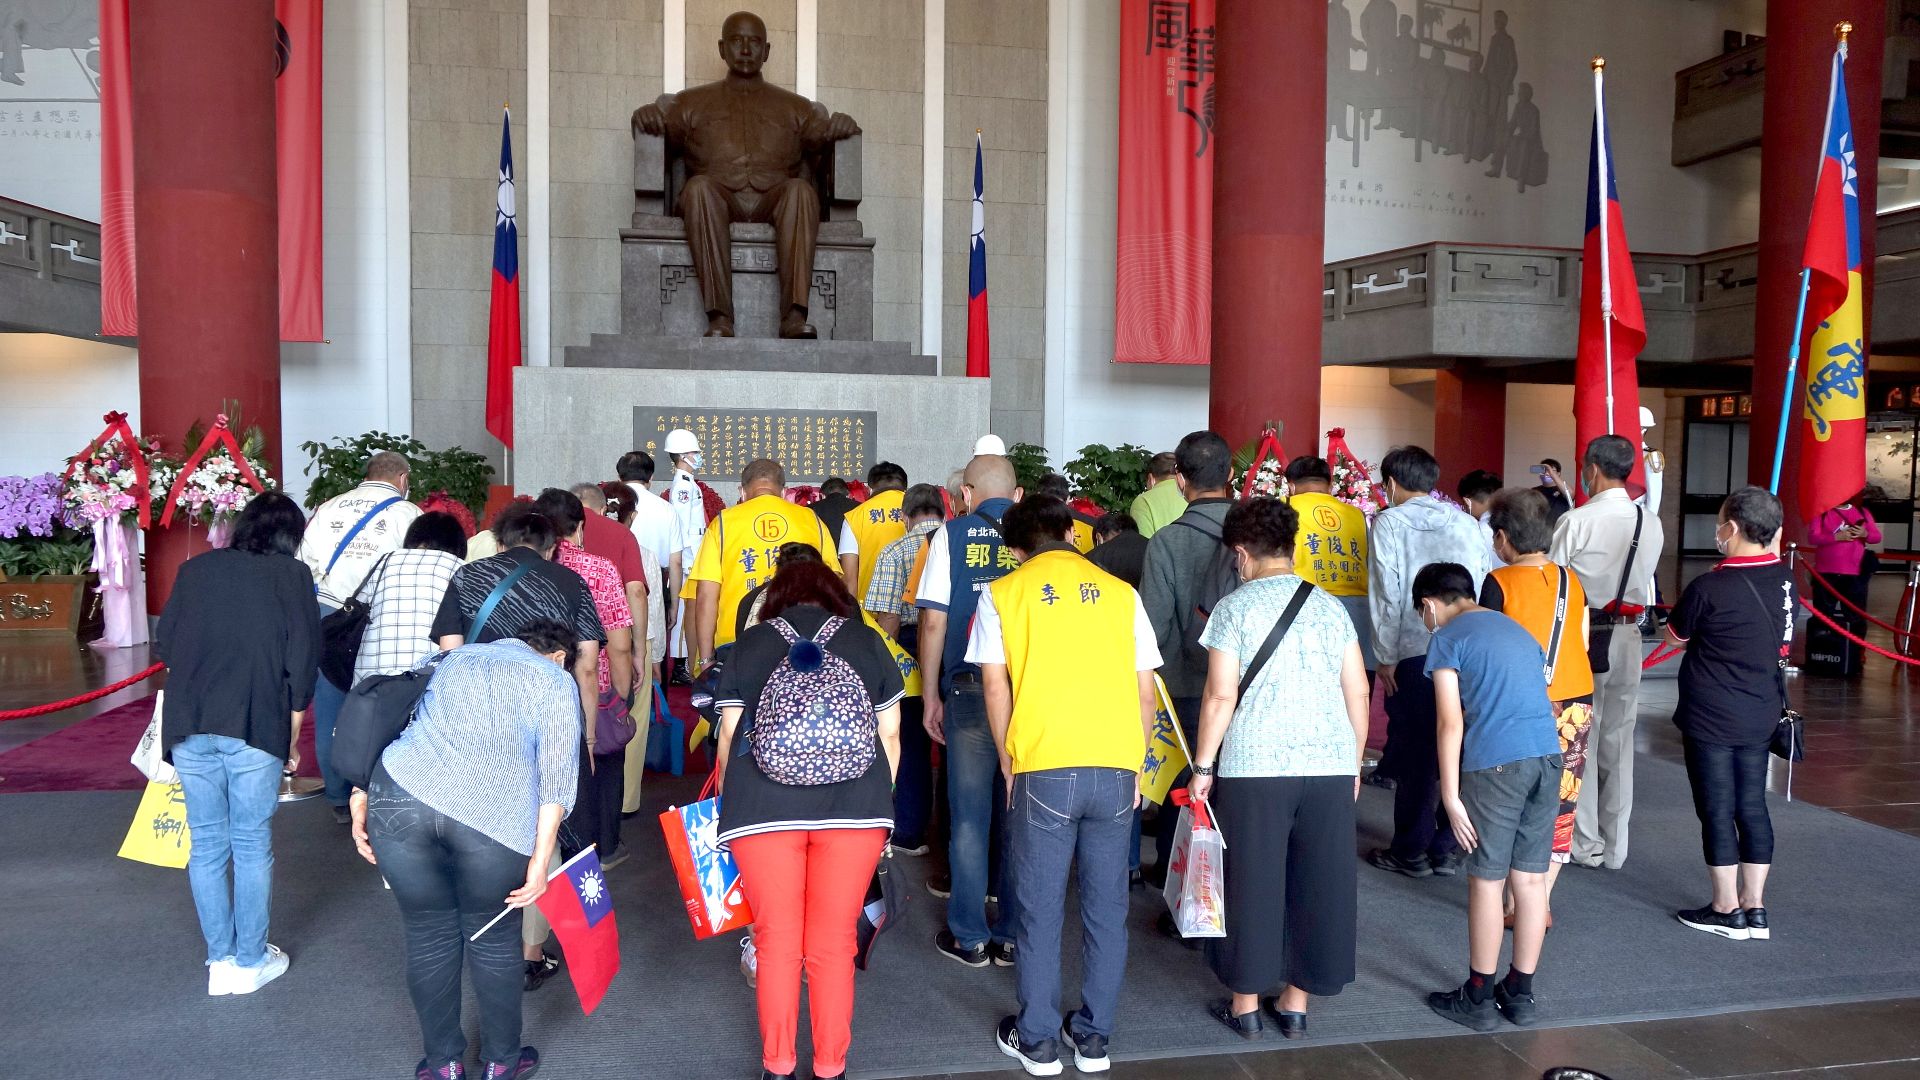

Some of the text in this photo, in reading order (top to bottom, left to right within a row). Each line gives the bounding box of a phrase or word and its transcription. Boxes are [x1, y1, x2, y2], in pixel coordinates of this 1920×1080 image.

[855, 418, 864, 475] 大道之行也天下
[1318, 509, 1336, 528] 15
[761, 519, 780, 538] 15
[967, 526, 1003, 539] 台北市
[1304, 532, 1362, 562] 董俊良
